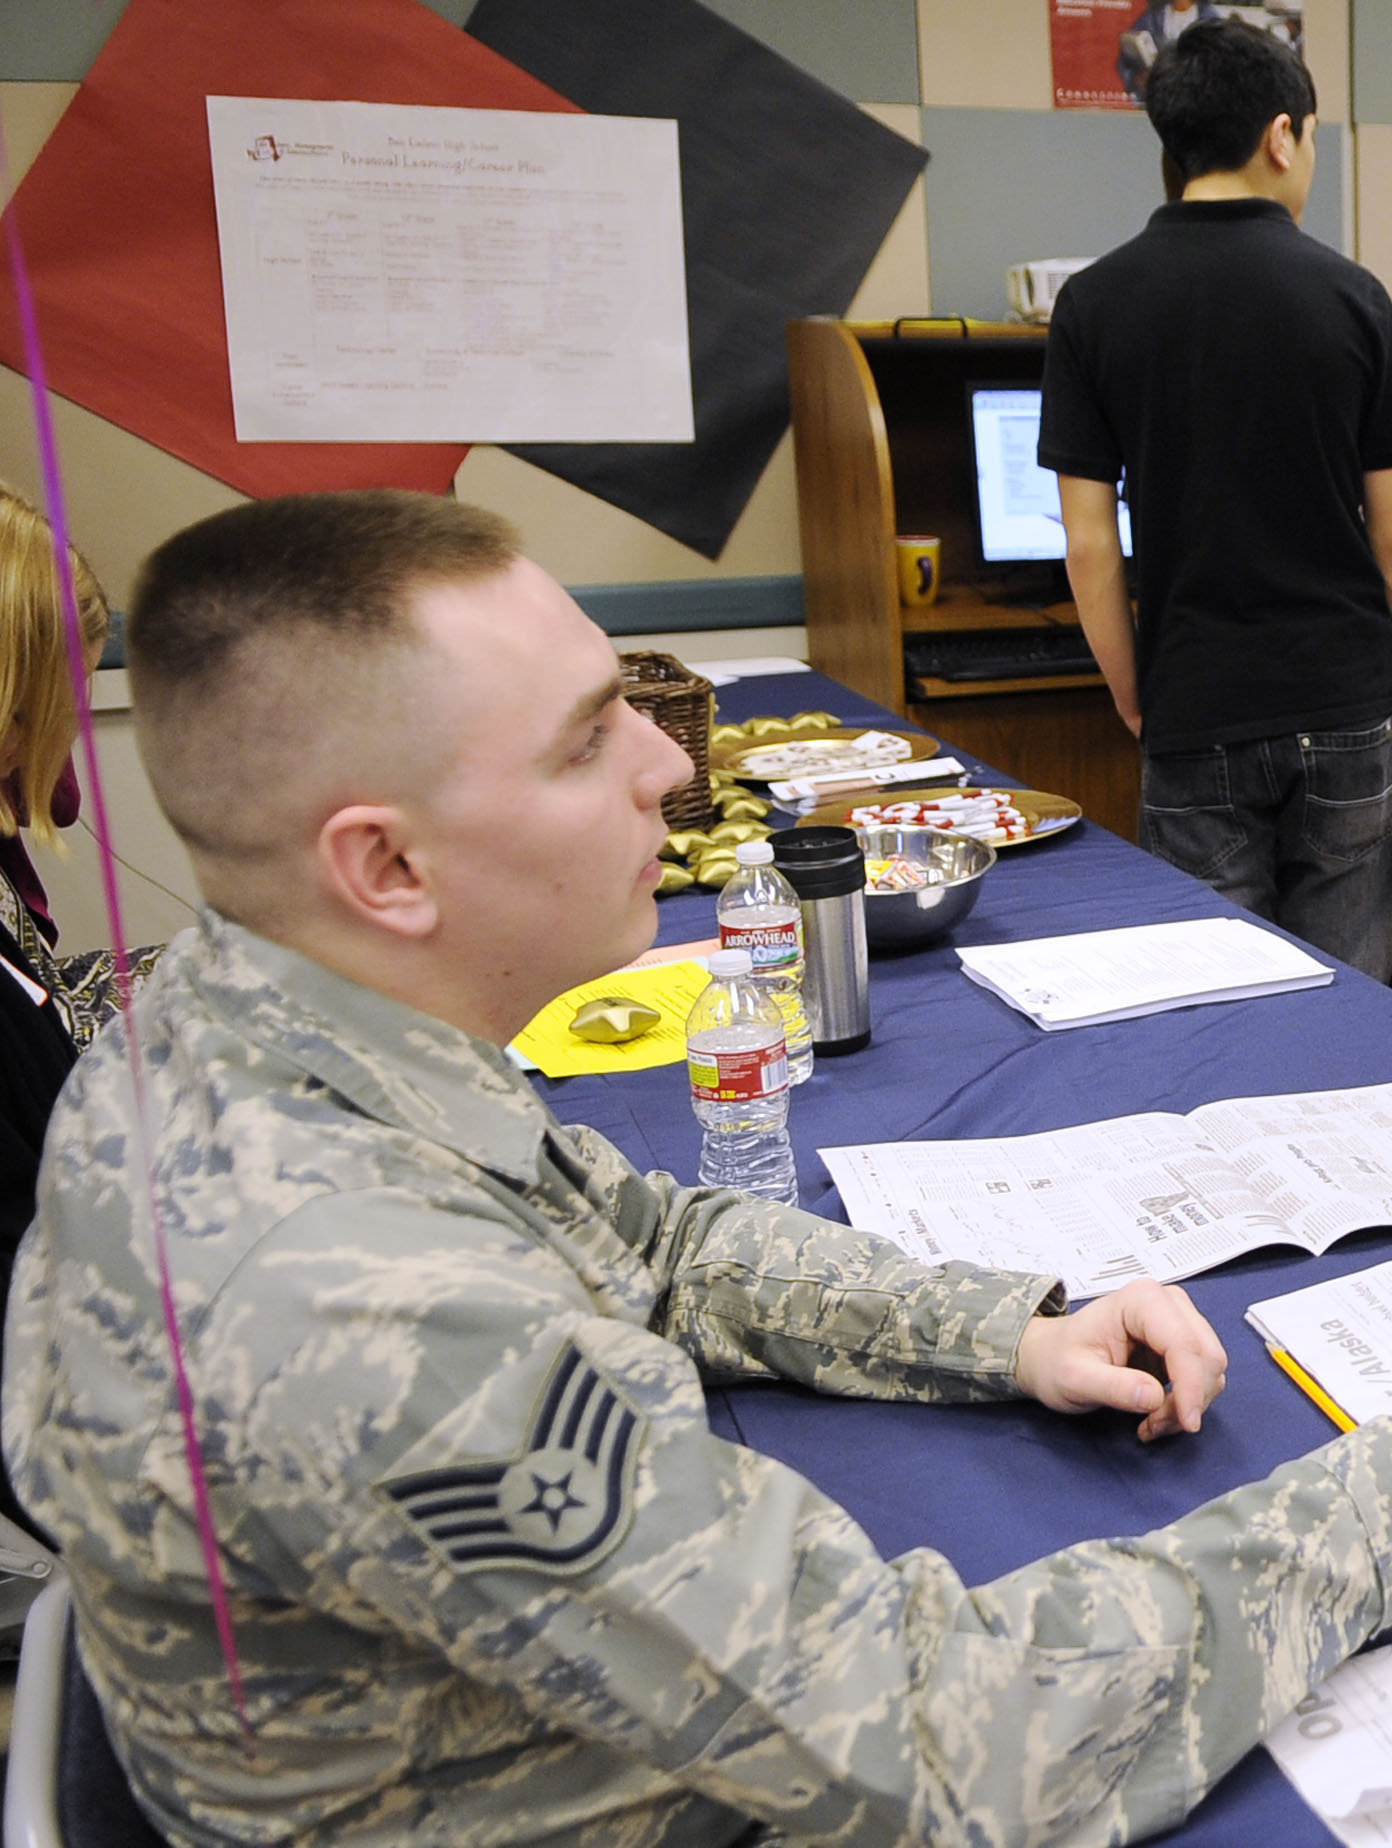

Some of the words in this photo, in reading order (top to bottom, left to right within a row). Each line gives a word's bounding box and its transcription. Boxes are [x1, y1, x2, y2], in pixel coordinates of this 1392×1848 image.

[341, 152, 398, 169] Personal
[517, 160, 546, 175] Plan
[724, 931, 796, 948] ARROWHEAD
